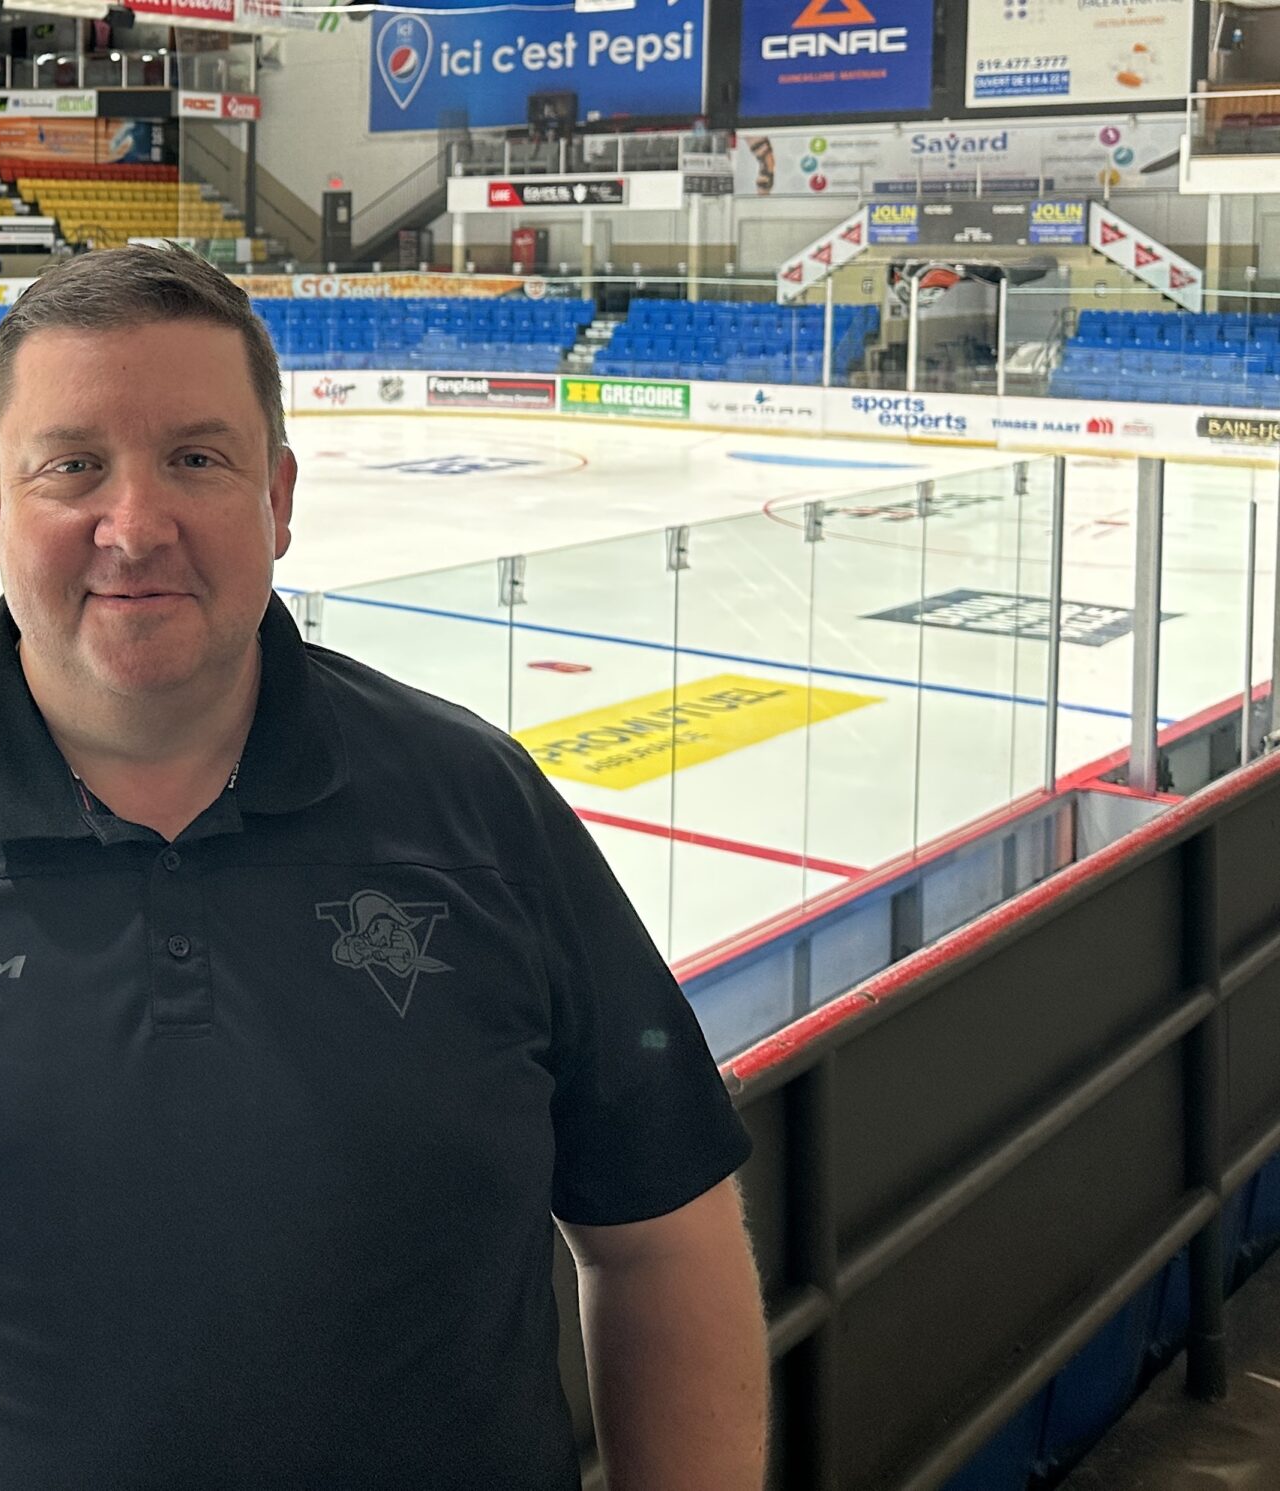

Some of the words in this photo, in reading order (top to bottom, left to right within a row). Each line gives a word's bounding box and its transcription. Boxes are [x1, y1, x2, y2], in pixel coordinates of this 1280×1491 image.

[441, 40, 482, 76] ici
[492, 33, 577, 72] c'est
[588, 21, 694, 72] Pepsi
[762, 27, 908, 60] CANAC
[911, 131, 1008, 154] Savard
[1032, 203, 1082, 219] JOLIN
[852, 395, 925, 413] sports
[878, 411, 967, 433] experts
[1043, 421, 1081, 432] MART
